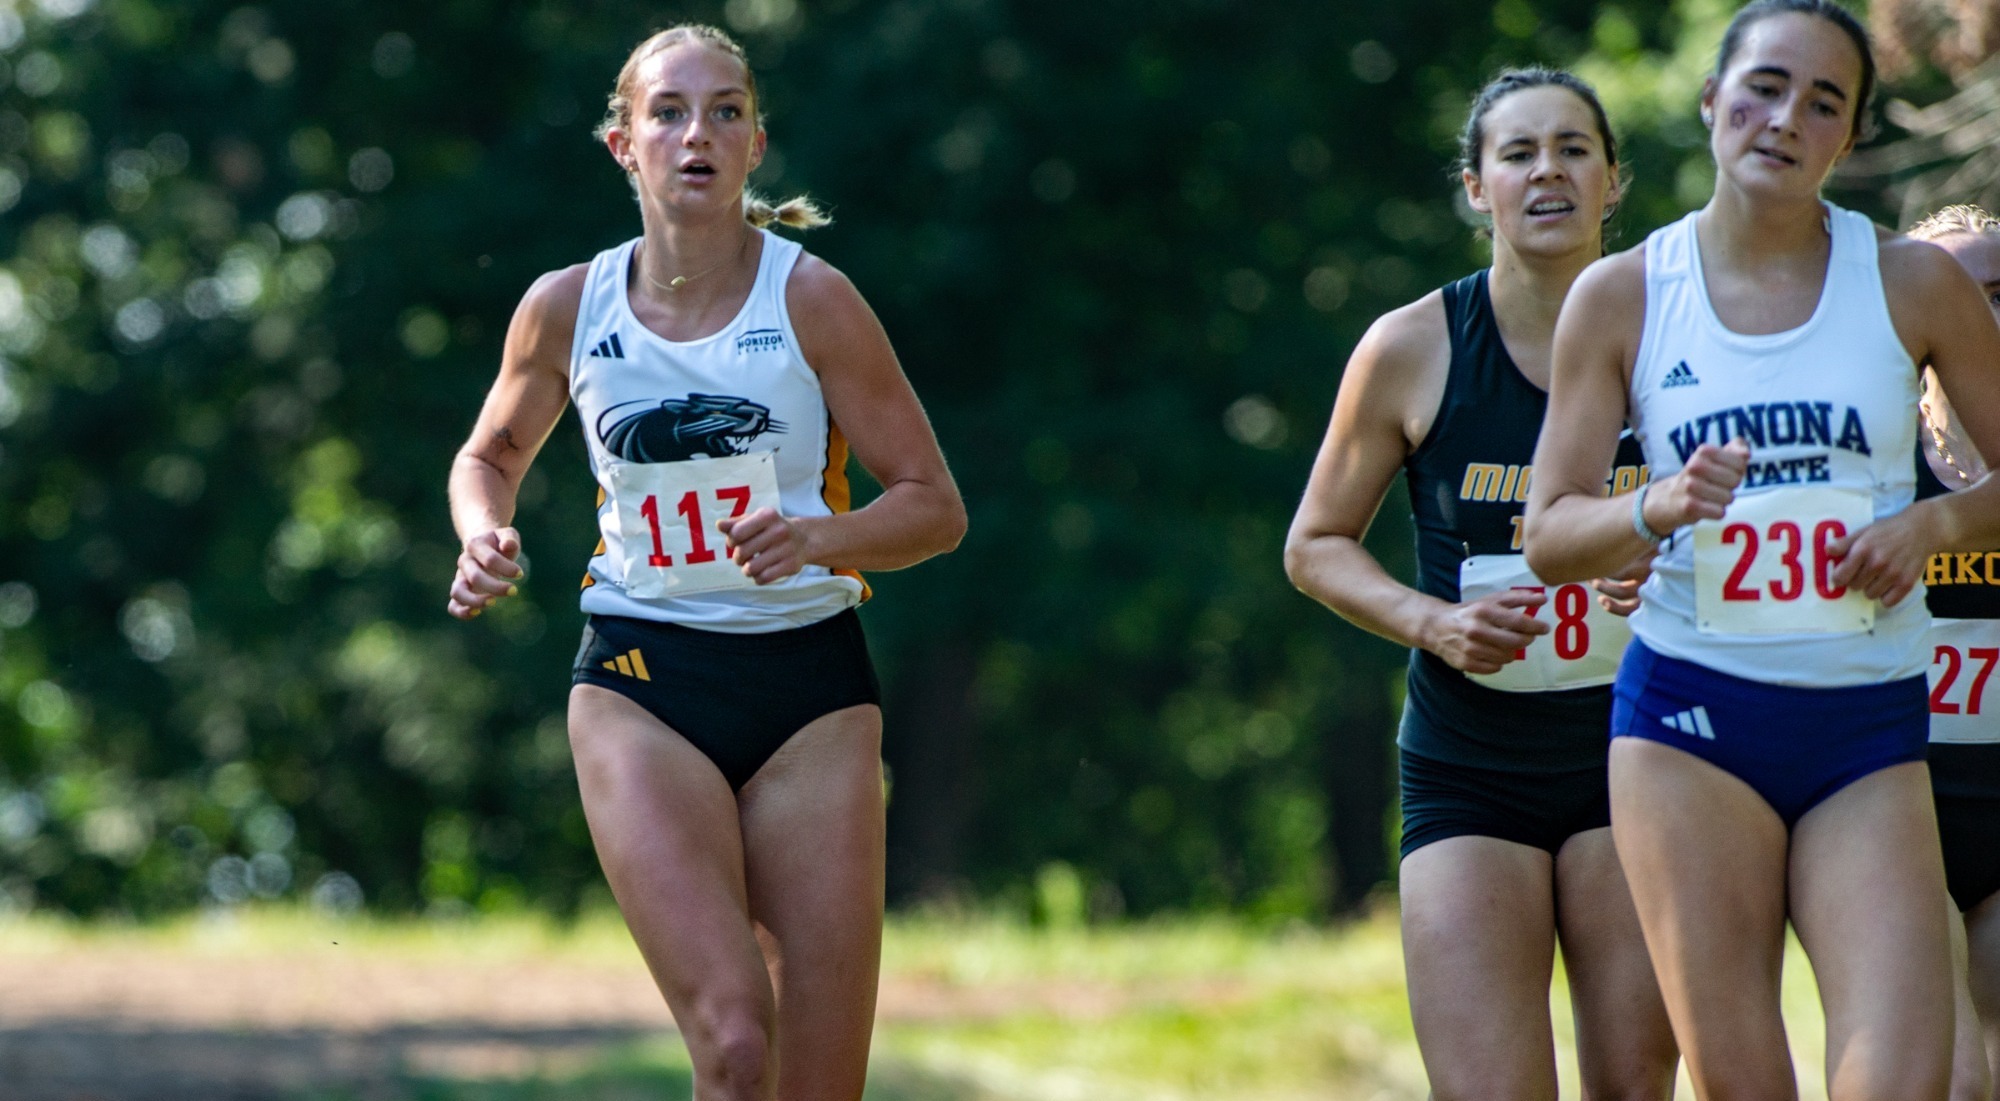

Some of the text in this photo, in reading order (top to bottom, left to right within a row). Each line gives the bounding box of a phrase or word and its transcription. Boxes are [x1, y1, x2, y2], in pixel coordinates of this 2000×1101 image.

[1668, 401, 1872, 466] WINONA
[1744, 454, 1831, 489] TATE
[640, 485, 752, 567] 117
[1720, 518, 1848, 602] 236
[1929, 645, 2000, 715] 27
